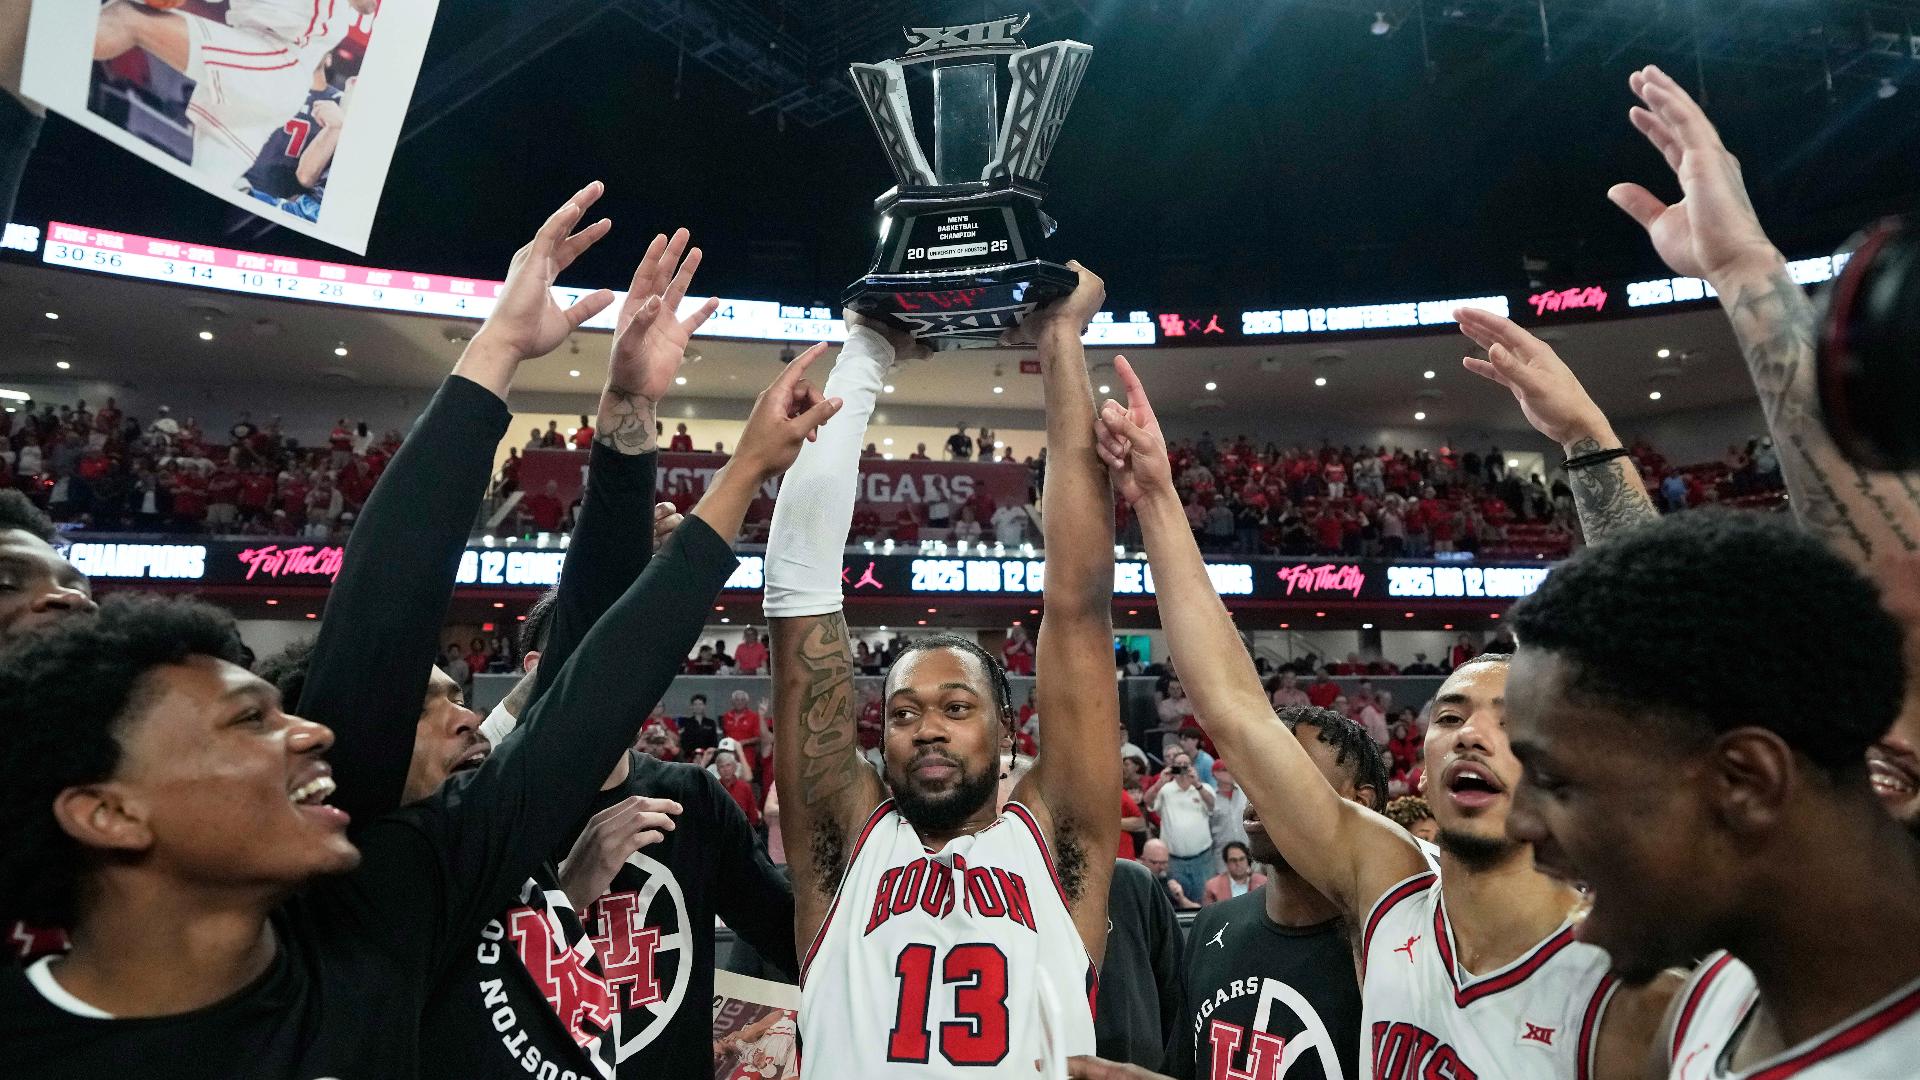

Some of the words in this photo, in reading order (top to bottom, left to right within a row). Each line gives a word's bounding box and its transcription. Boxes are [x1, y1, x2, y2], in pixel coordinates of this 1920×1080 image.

[284, 119, 310, 158] 7
[937, 223, 979, 232] BASKETBALL
[947, 215, 969, 223] MEN'S
[939, 231, 976, 240] CHAMPION
[907, 247, 925, 260] 20
[929, 249, 957, 257] UNIVERSITY
[964, 246, 987, 254] HOUSTON
[990, 239, 1008, 252] 25
[163, 261, 175, 275] 3
[240, 273, 263, 287] 10
[276, 277, 299, 291] 12
[319, 283, 343, 297] 28
[911, 560, 965, 592] 2025
[887, 943, 1009, 1067] 13
